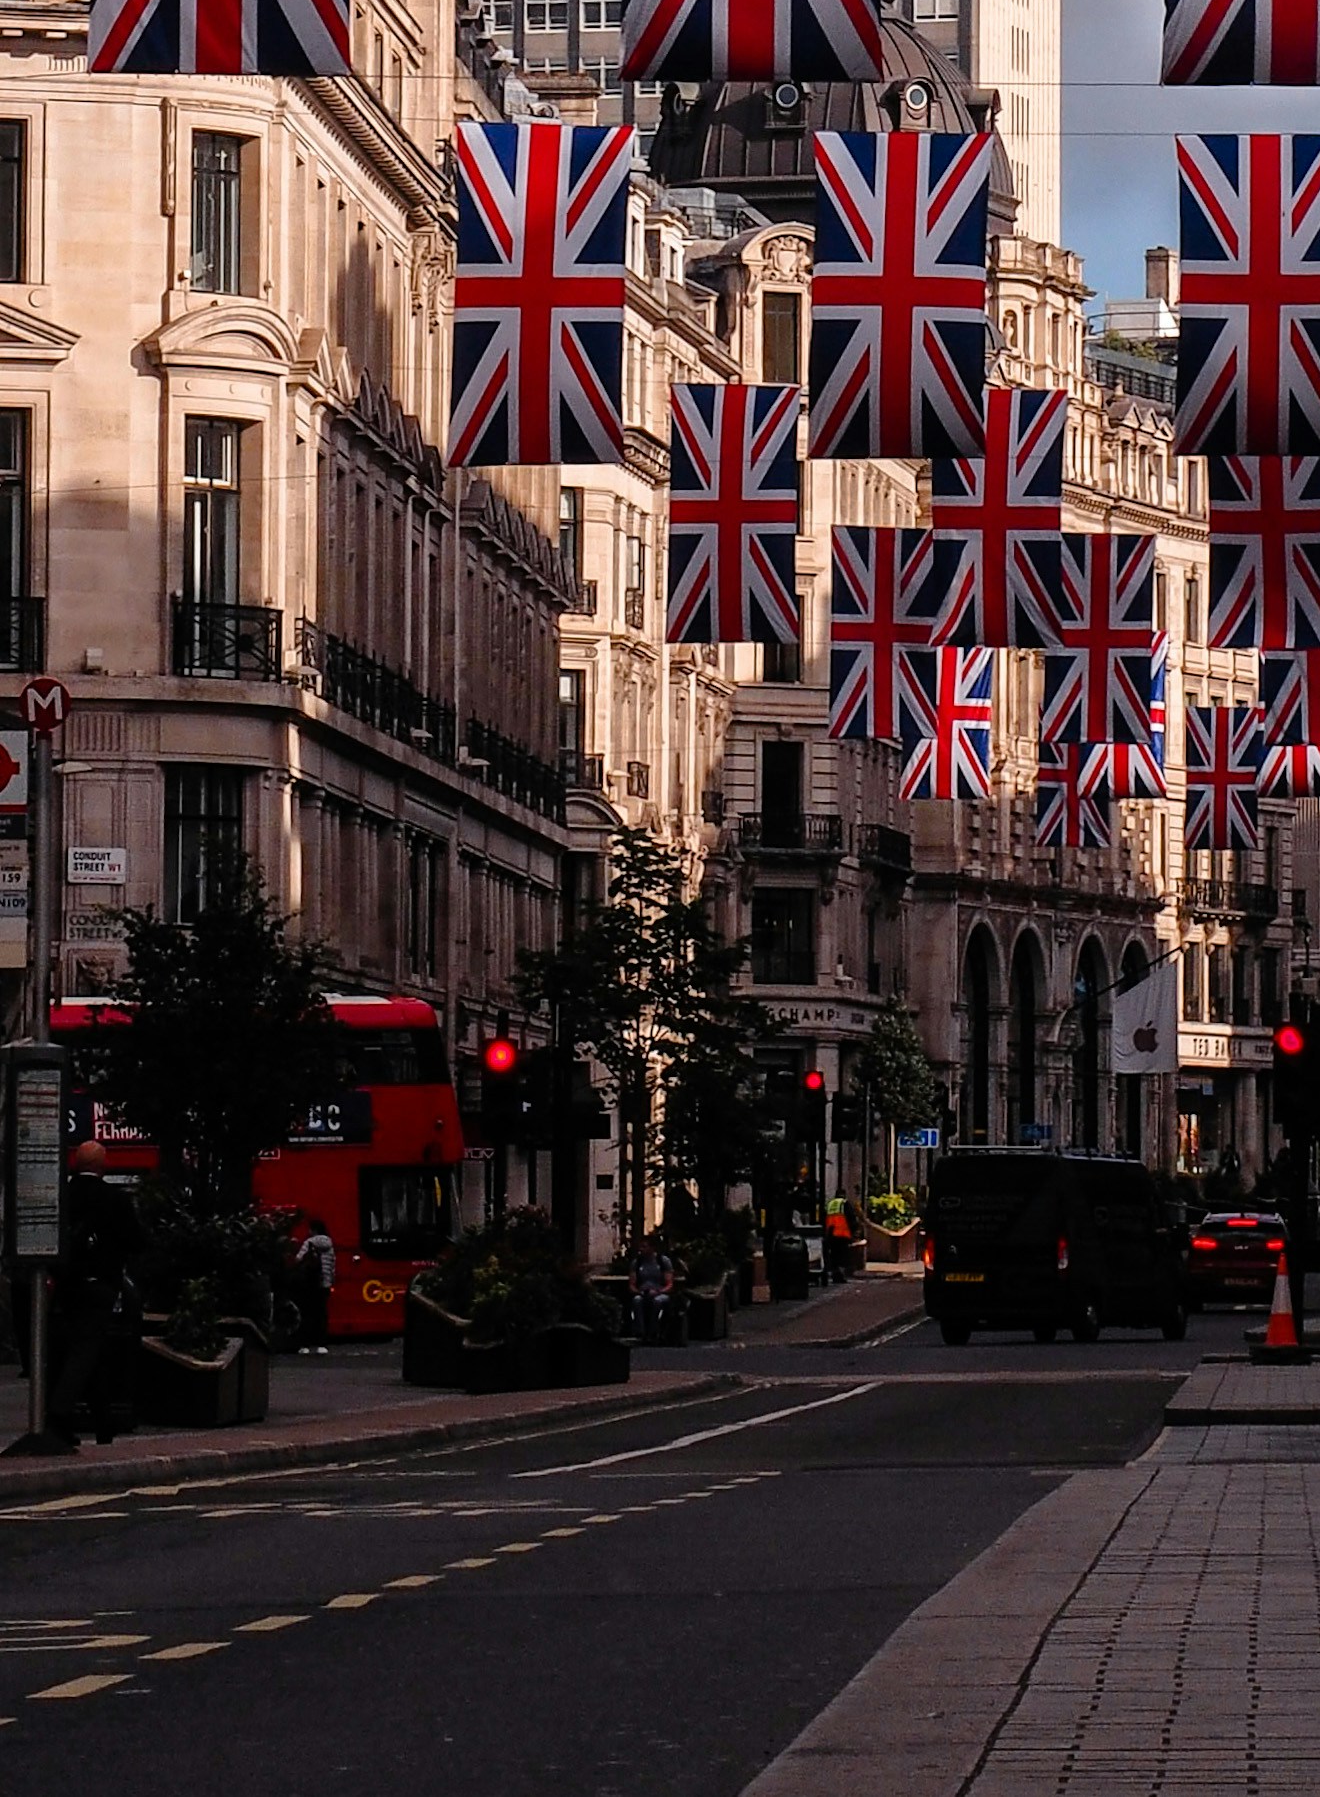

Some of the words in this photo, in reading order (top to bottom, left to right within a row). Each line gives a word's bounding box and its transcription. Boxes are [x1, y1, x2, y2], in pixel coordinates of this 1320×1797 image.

[26, 684, 63, 723] M
[73, 851, 111, 861] CONDUIT
[73, 862, 105, 872] STREET
[2, 873, 21, 883] 159
